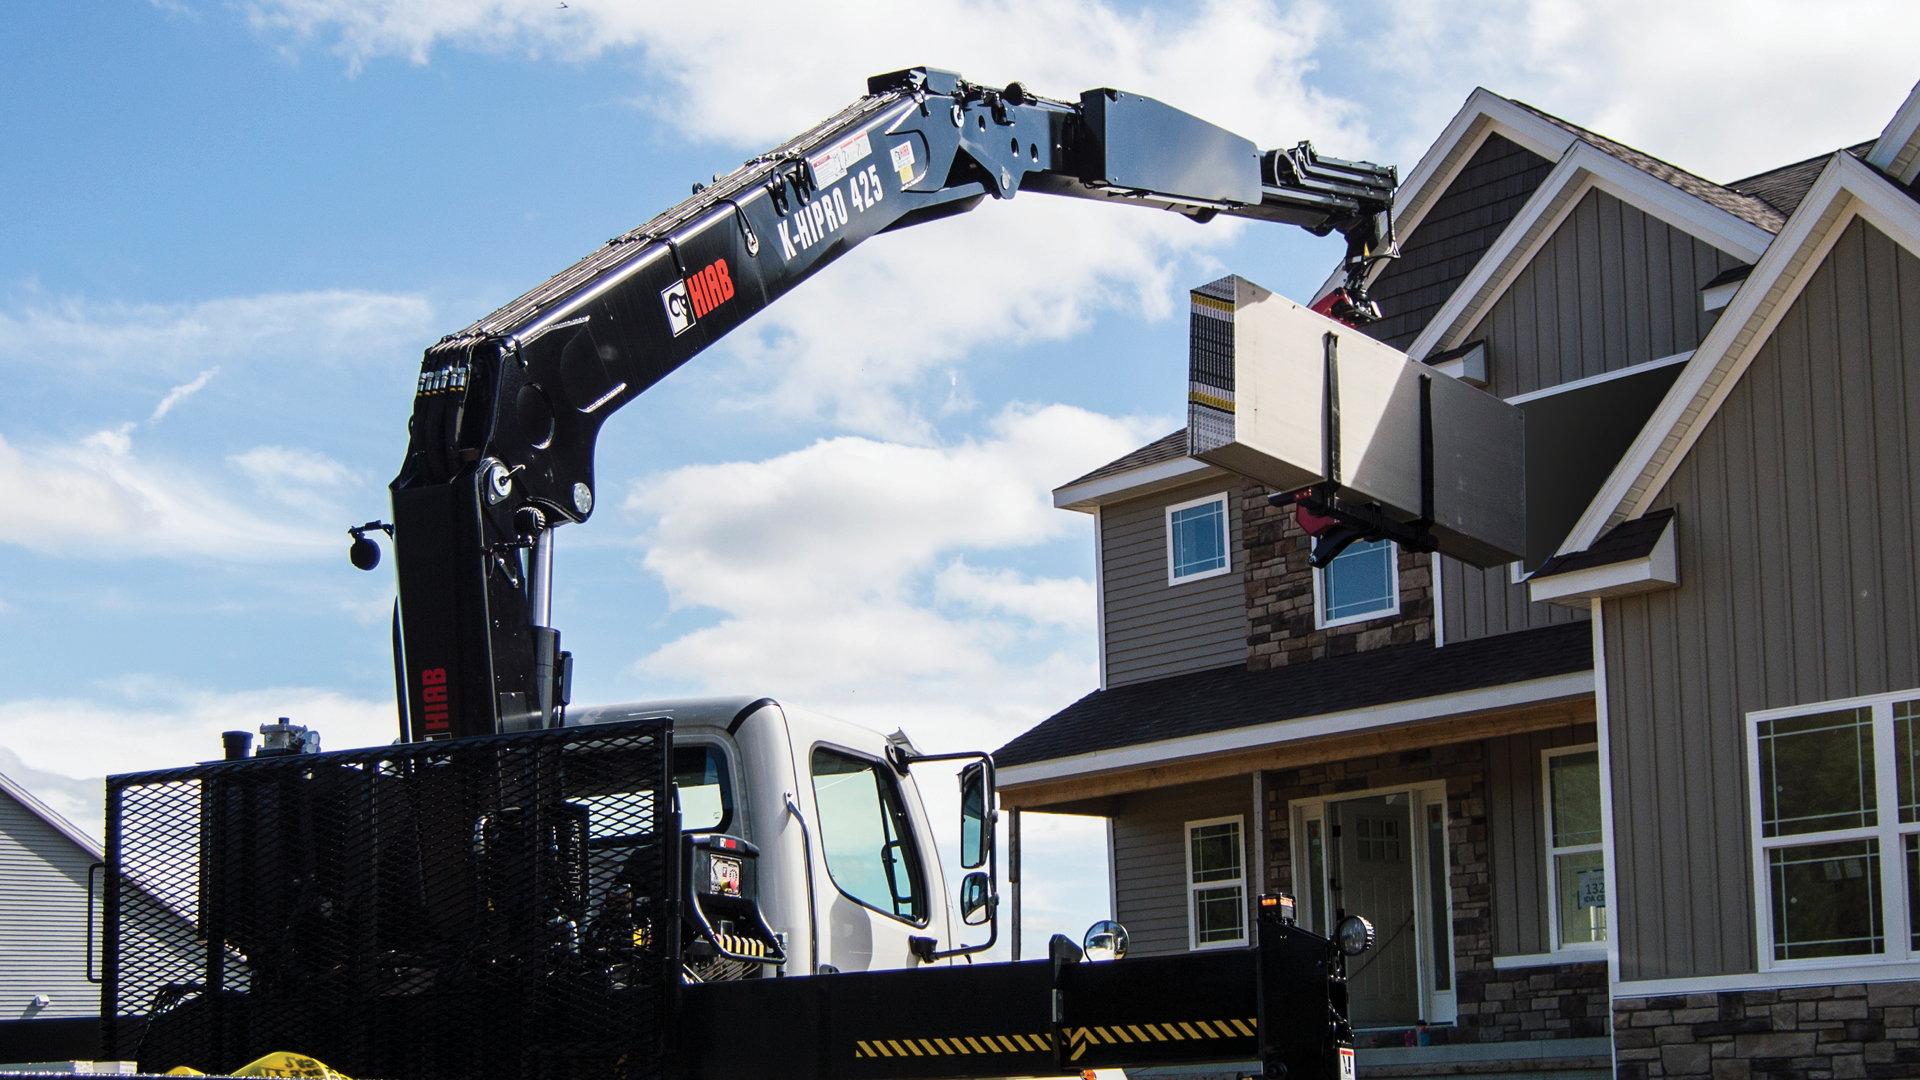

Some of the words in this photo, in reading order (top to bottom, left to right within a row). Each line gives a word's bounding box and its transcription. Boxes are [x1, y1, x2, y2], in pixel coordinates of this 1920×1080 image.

[777, 187, 848, 260] K-HIPRO
[850, 164, 883, 212] 425
[686, 258, 734, 319] HIAB
[422, 668, 449, 730] HIAB
